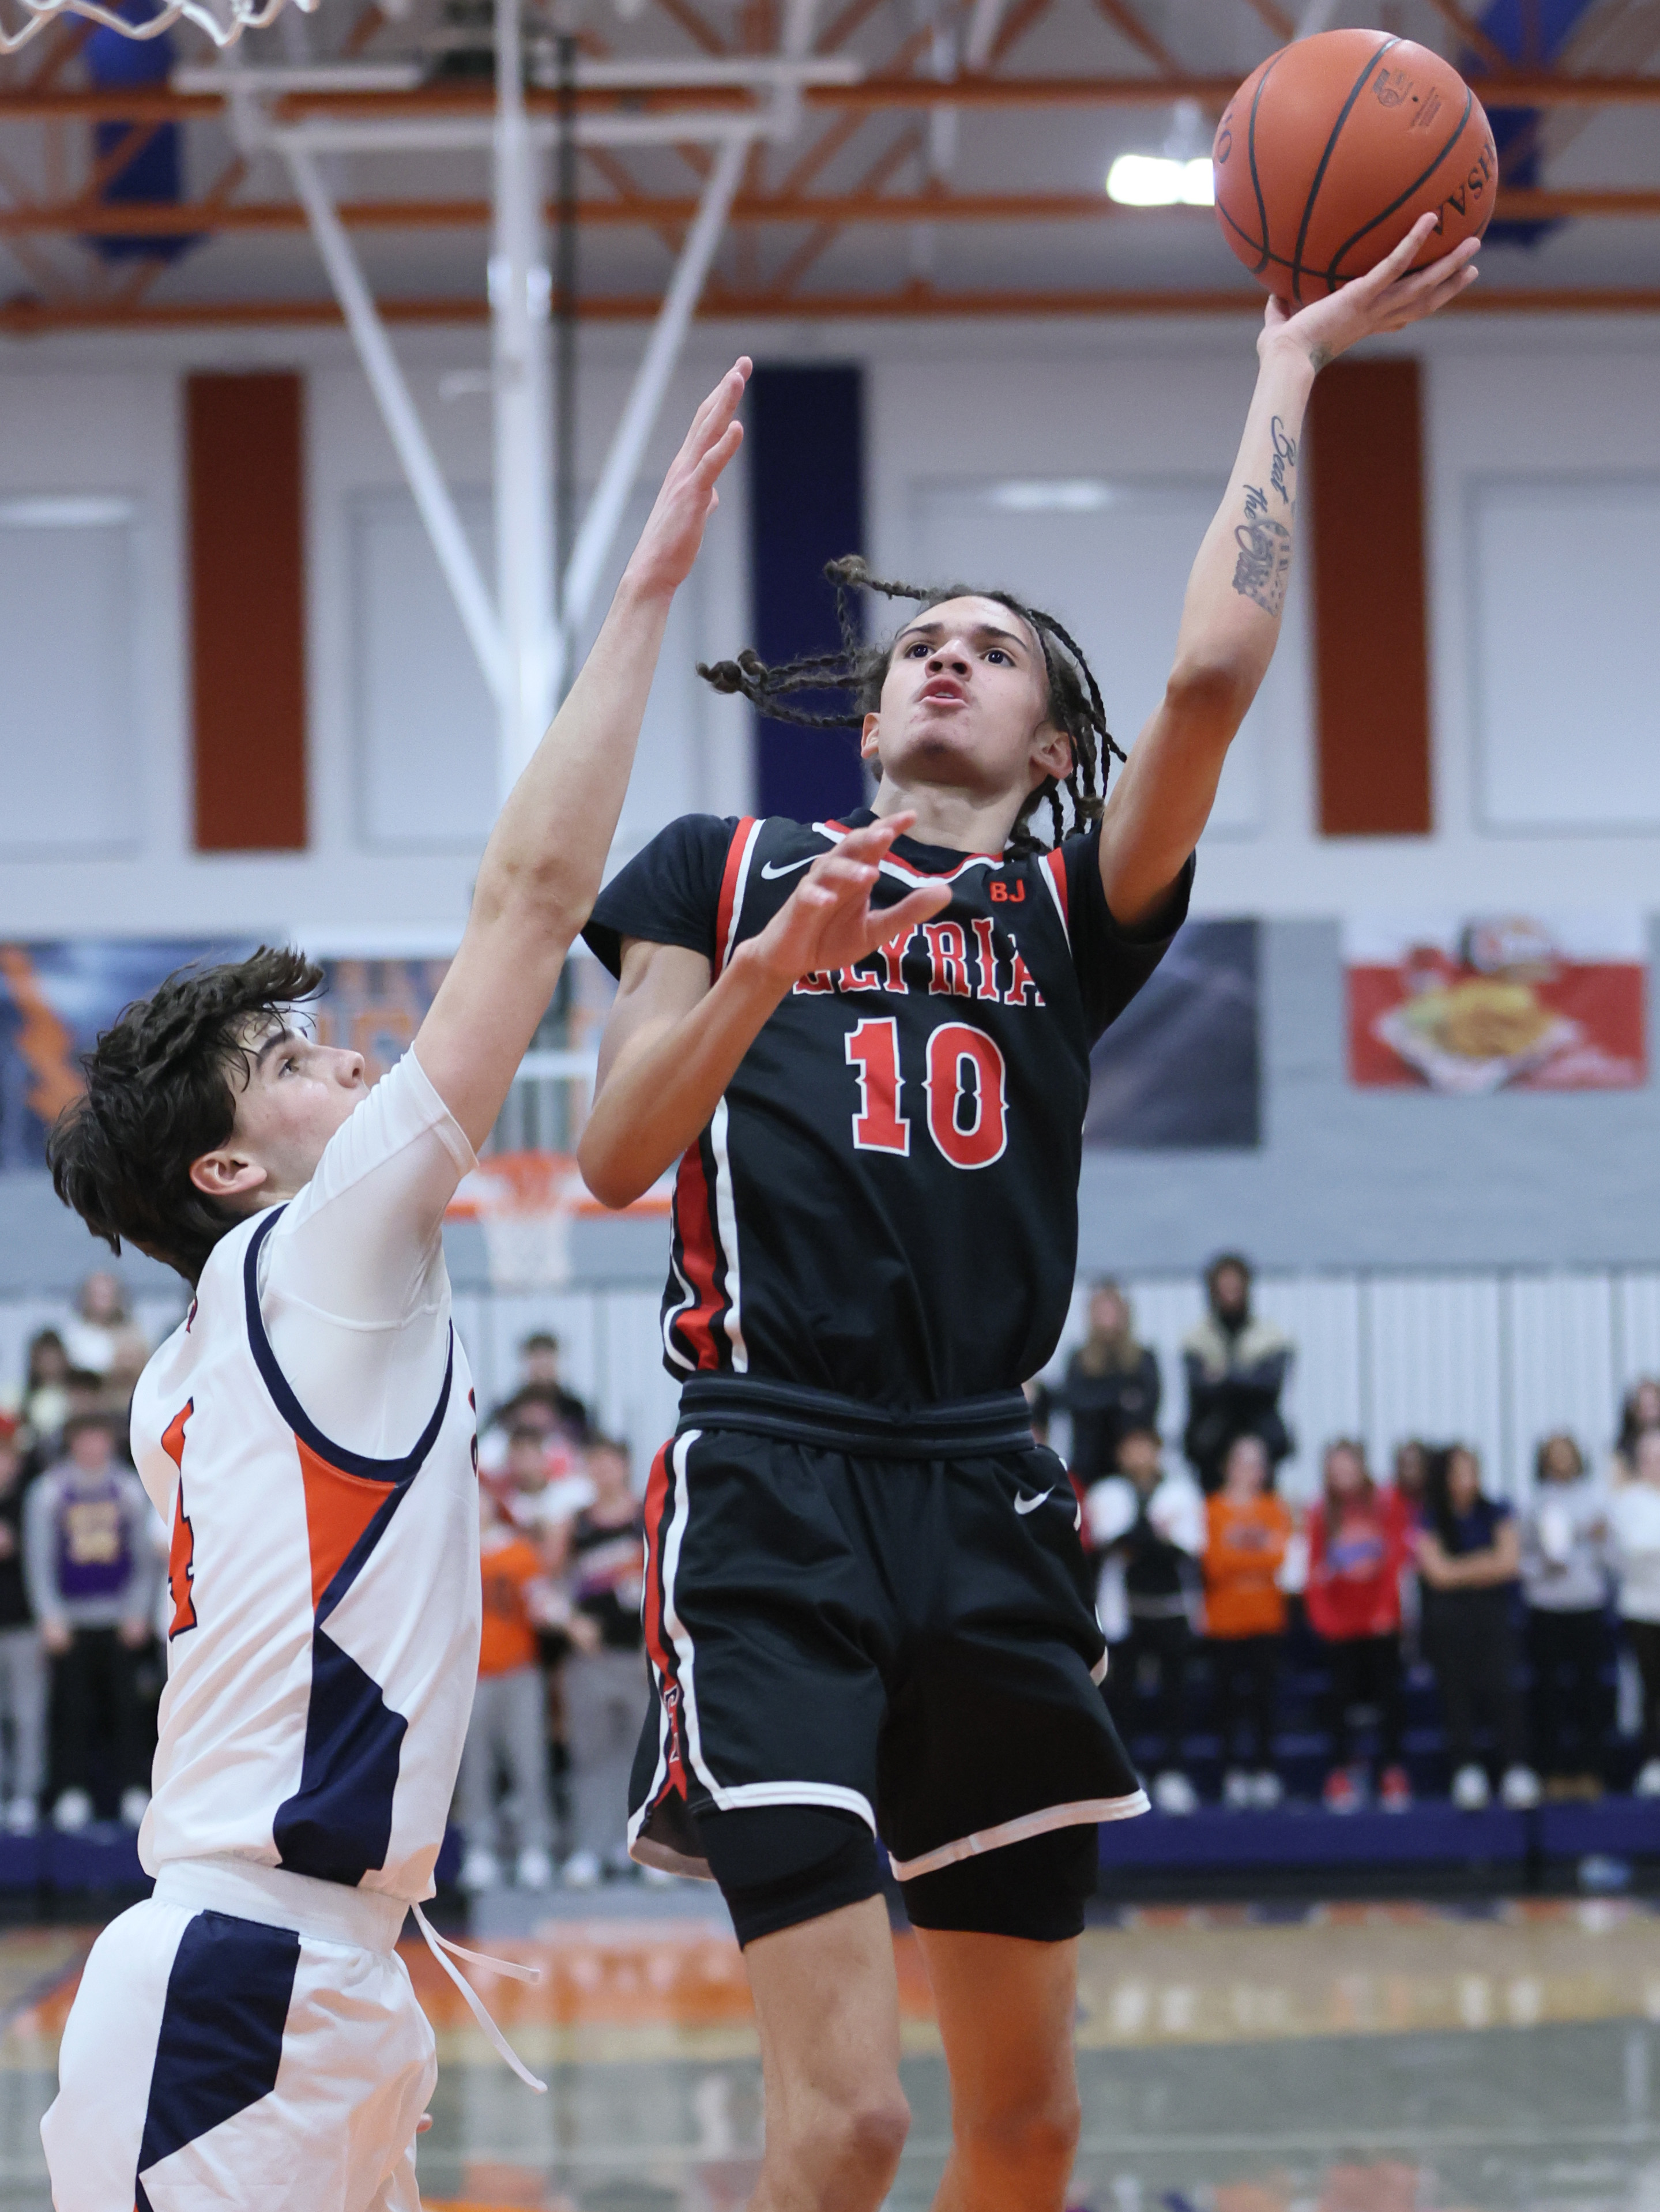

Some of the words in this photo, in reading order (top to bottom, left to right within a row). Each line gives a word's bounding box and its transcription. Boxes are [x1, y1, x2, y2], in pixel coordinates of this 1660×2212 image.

[1271, 415, 1296, 504] Beat
[989, 878, 1026, 902] BJ
[845, 1017, 1009, 1169] 10
